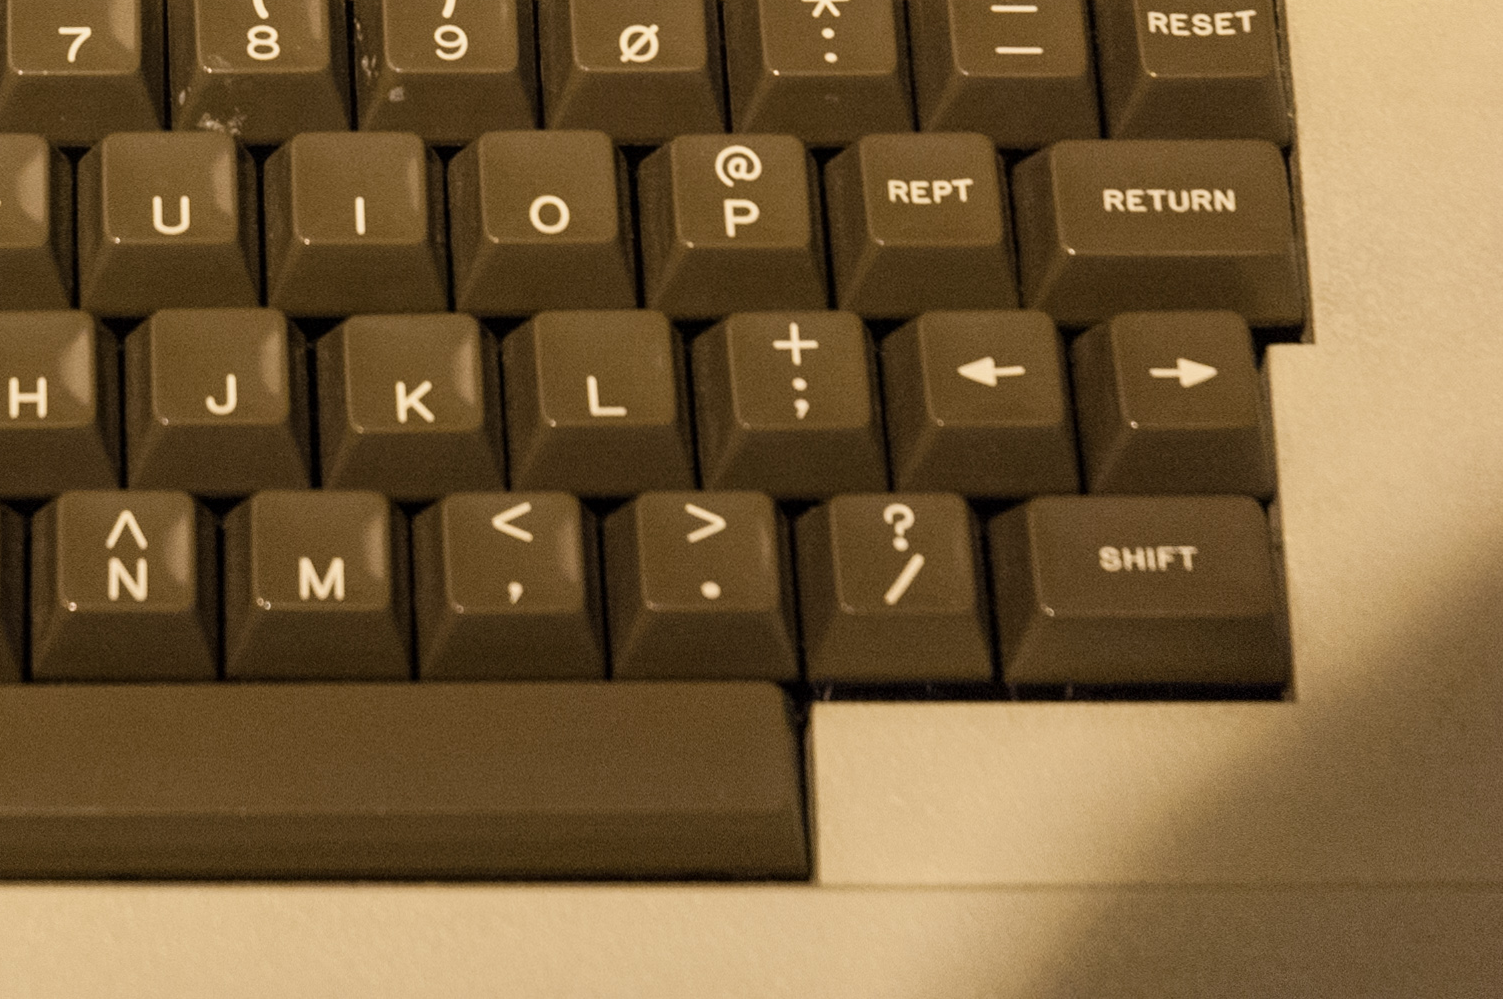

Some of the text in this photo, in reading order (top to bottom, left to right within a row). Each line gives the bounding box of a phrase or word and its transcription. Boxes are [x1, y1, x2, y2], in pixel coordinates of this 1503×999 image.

[245, 24, 282, 61] 8
[433, 23, 469, 62] 9
[1146, 8, 1257, 37] RESET
[57, 25, 93, 64] 7
[886, 177, 974, 205] REPT
[1102, 188, 1237, 213] RETURN
[151, 194, 191, 236] U
[354, 195, 367, 236] I
[528, 194, 571, 235] O
[722, 198, 761, 238] P
[8, 376, 48, 419] H
[205, 373, 238, 416] J
[394, 379, 435, 424] K
[586, 374, 628, 417] L
[107, 556, 149, 602] N
[298, 556, 346, 600] M
[1098, 545, 1197, 572] SHIFT
